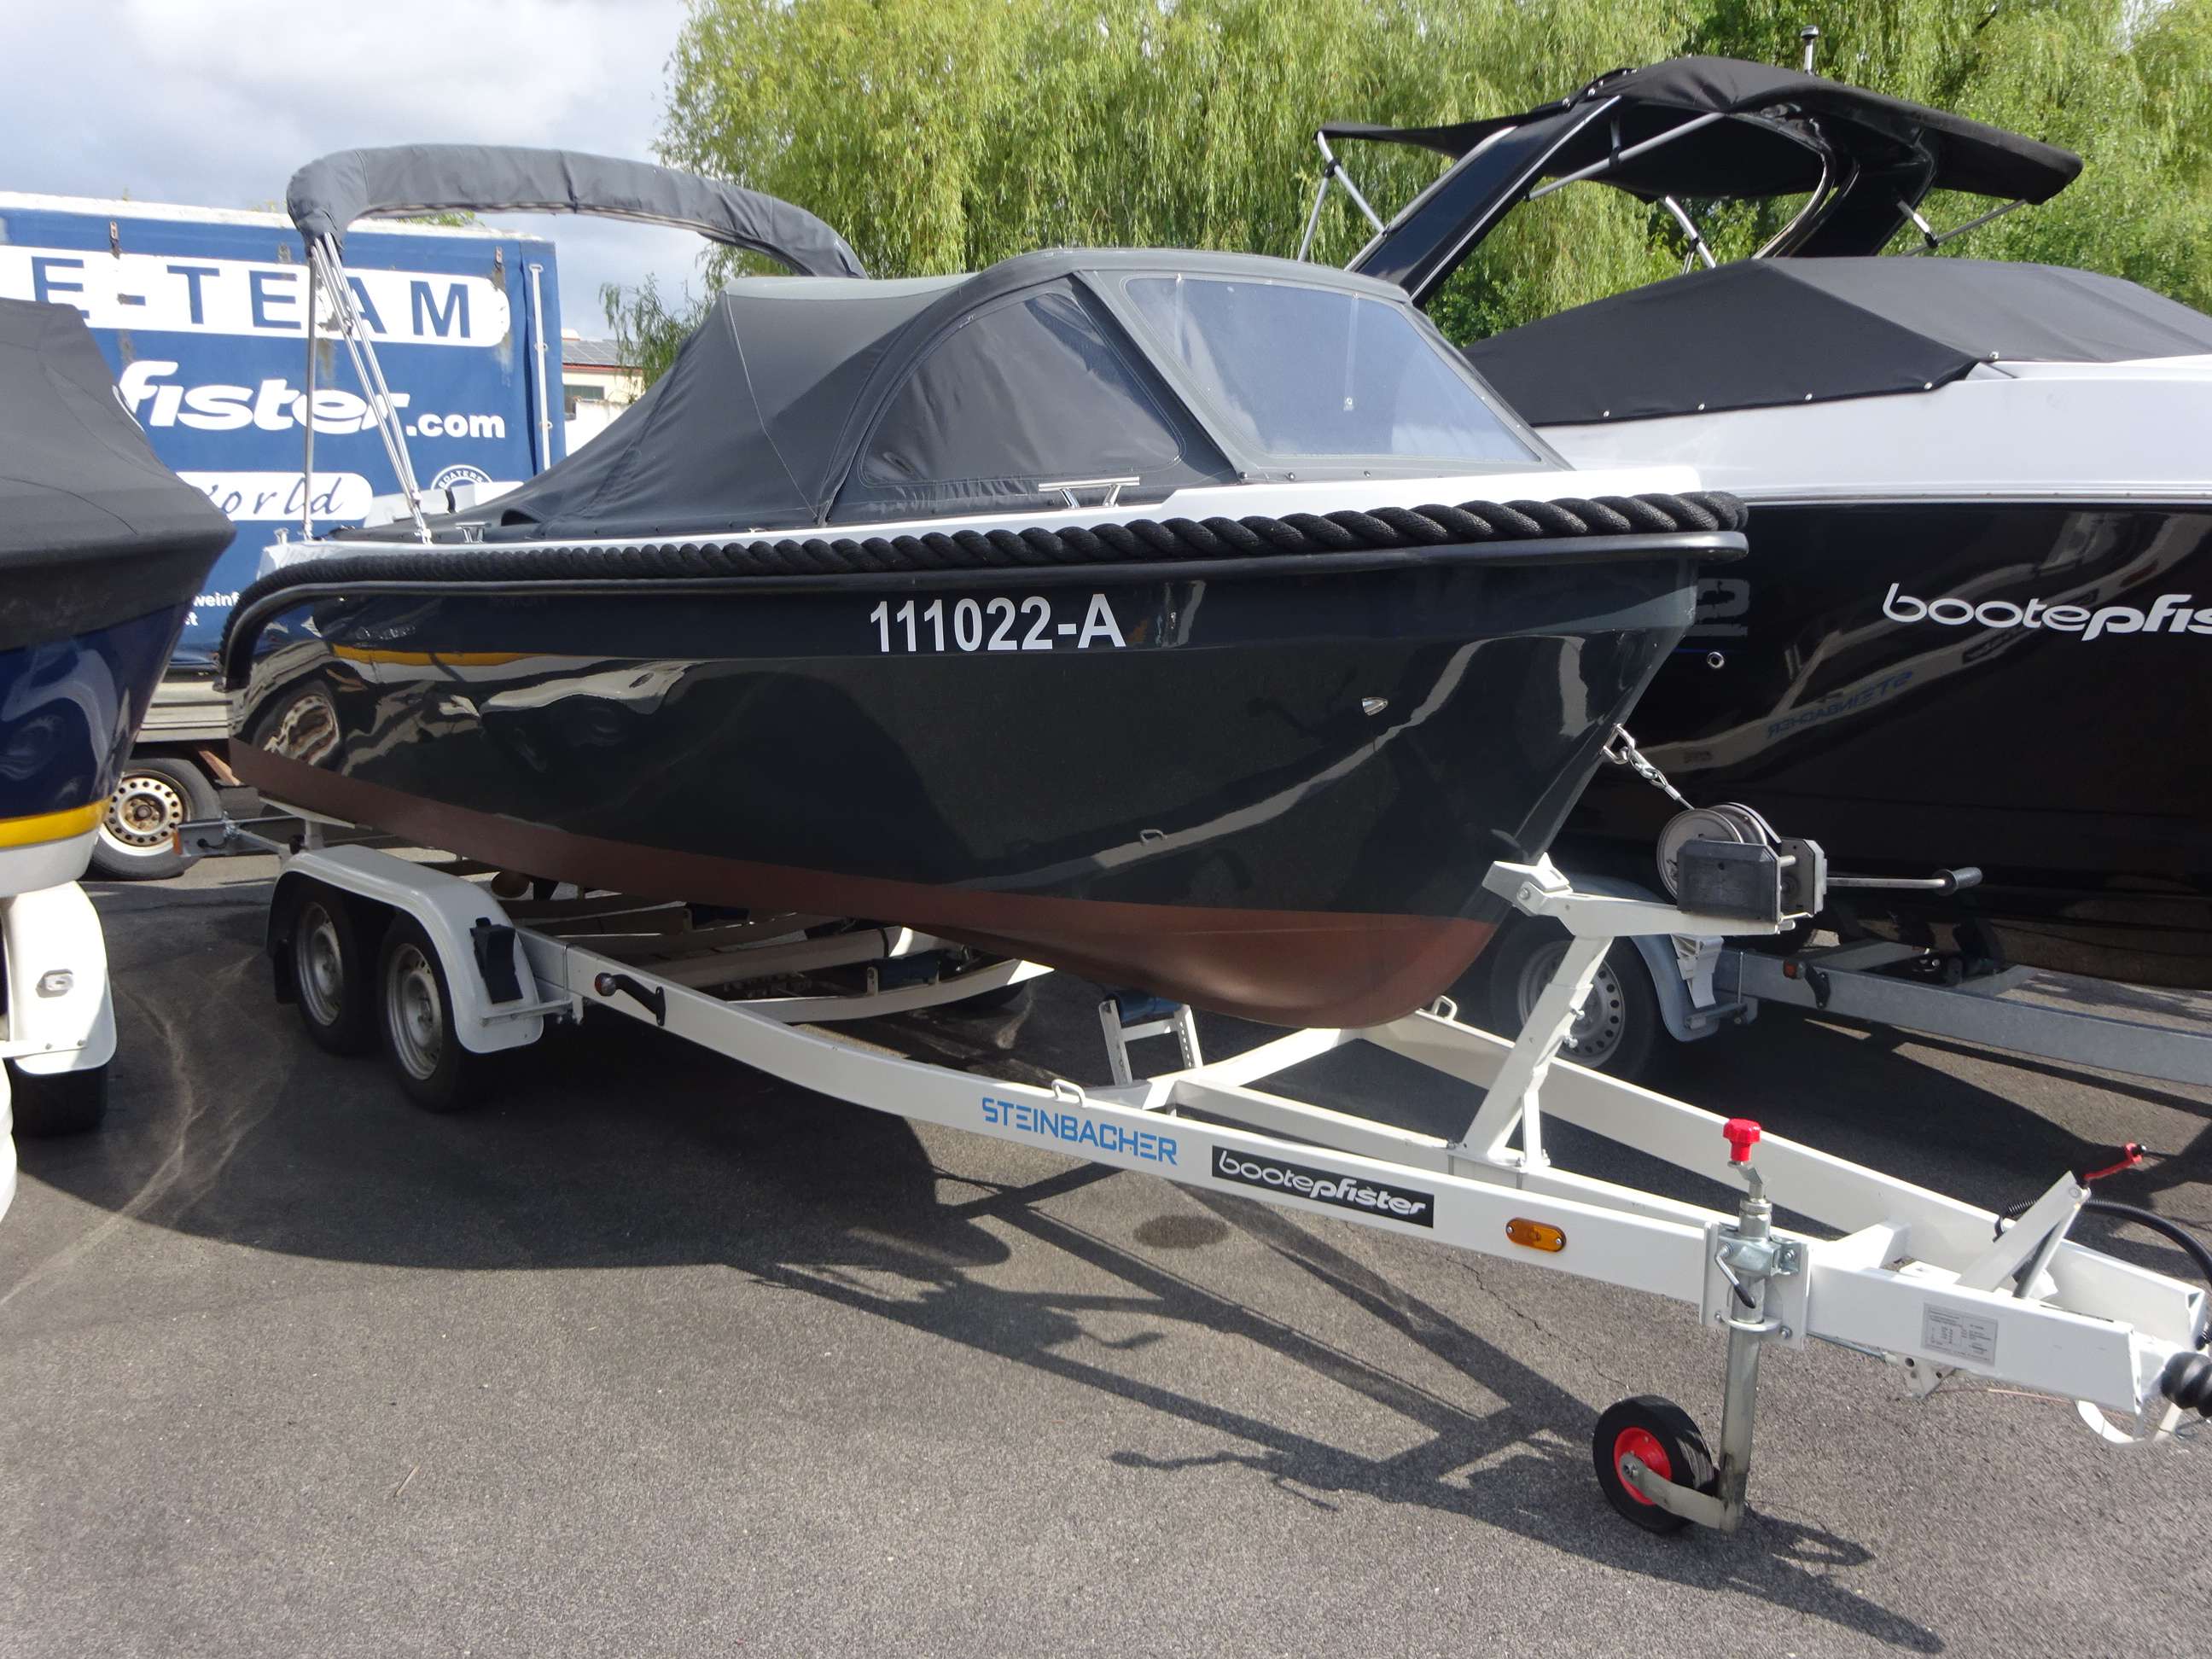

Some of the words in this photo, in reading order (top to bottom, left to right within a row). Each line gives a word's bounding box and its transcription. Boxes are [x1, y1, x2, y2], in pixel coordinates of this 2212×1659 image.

[113, 361, 506, 439] fister.com
[207, 476, 343, 515] orld
[870, 593, 1126, 653] 111022-A
[981, 1097, 1179, 1167] STEINBACHER
[1218, 1150, 1428, 1215] bootepfister
